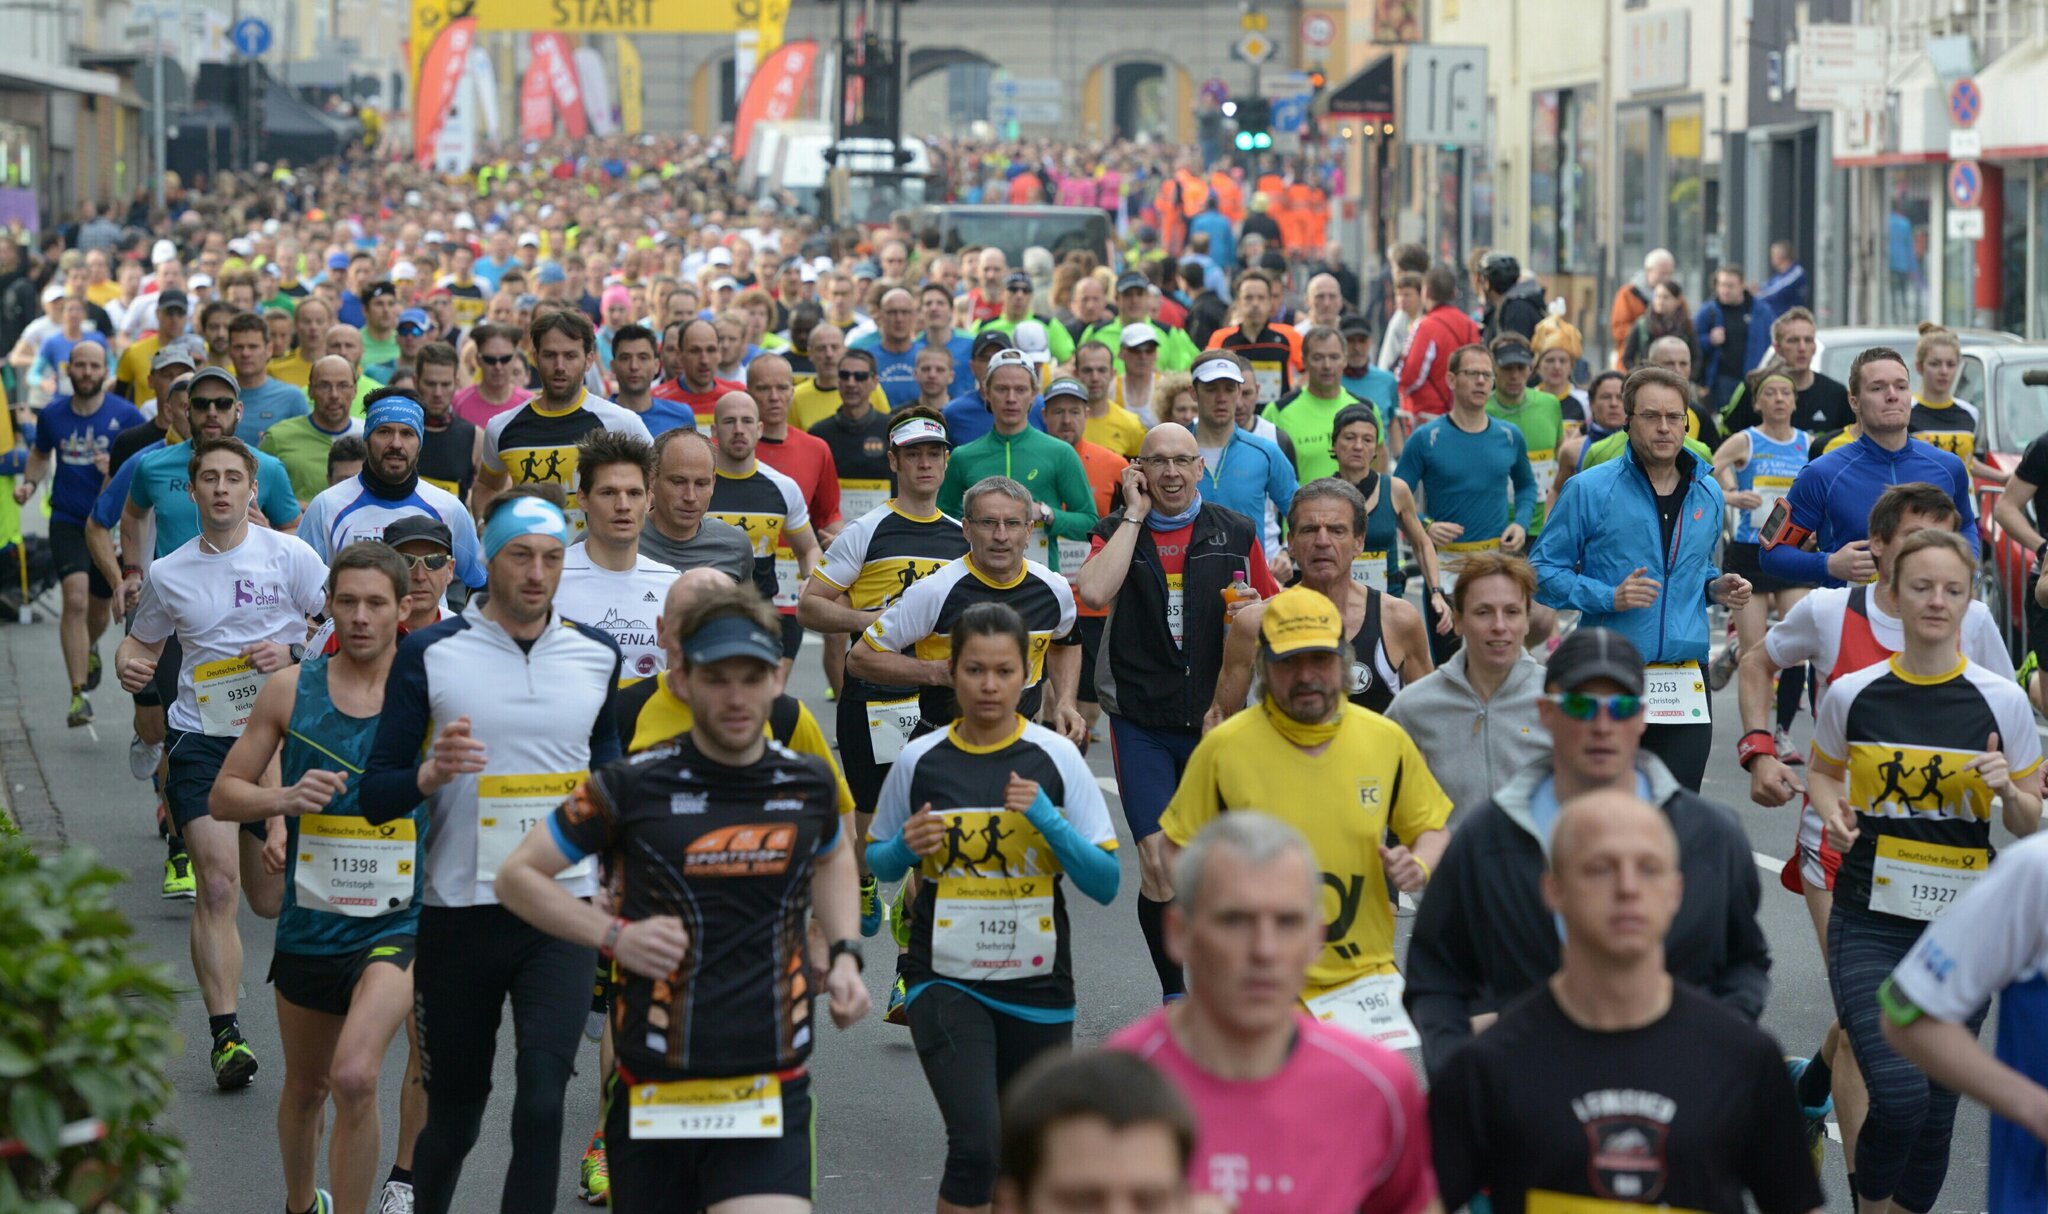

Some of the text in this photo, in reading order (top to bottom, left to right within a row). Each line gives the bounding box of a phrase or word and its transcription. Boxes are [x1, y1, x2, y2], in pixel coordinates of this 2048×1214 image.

[552, 0, 654, 26] START
[206, 665, 236, 678] Deutsche
[227, 684, 257, 702] 9359
[1649, 681, 1677, 693] 2263
[234, 702, 254, 712] Nicla
[1649, 697, 1681, 705] Christoph
[1360, 787, 1379, 804] FC
[316, 825, 377, 837] Deutsche Post
[1897, 849, 1960, 867] Deutsche Post
[332, 857, 378, 874] 11398
[331, 878, 375, 891] Christoph
[956, 888, 1018, 897] Deutsche Post
[1911, 883, 1958, 904] 13327
[979, 920, 1018, 935] 1429
[975, 942, 1017, 952] Shehrina
